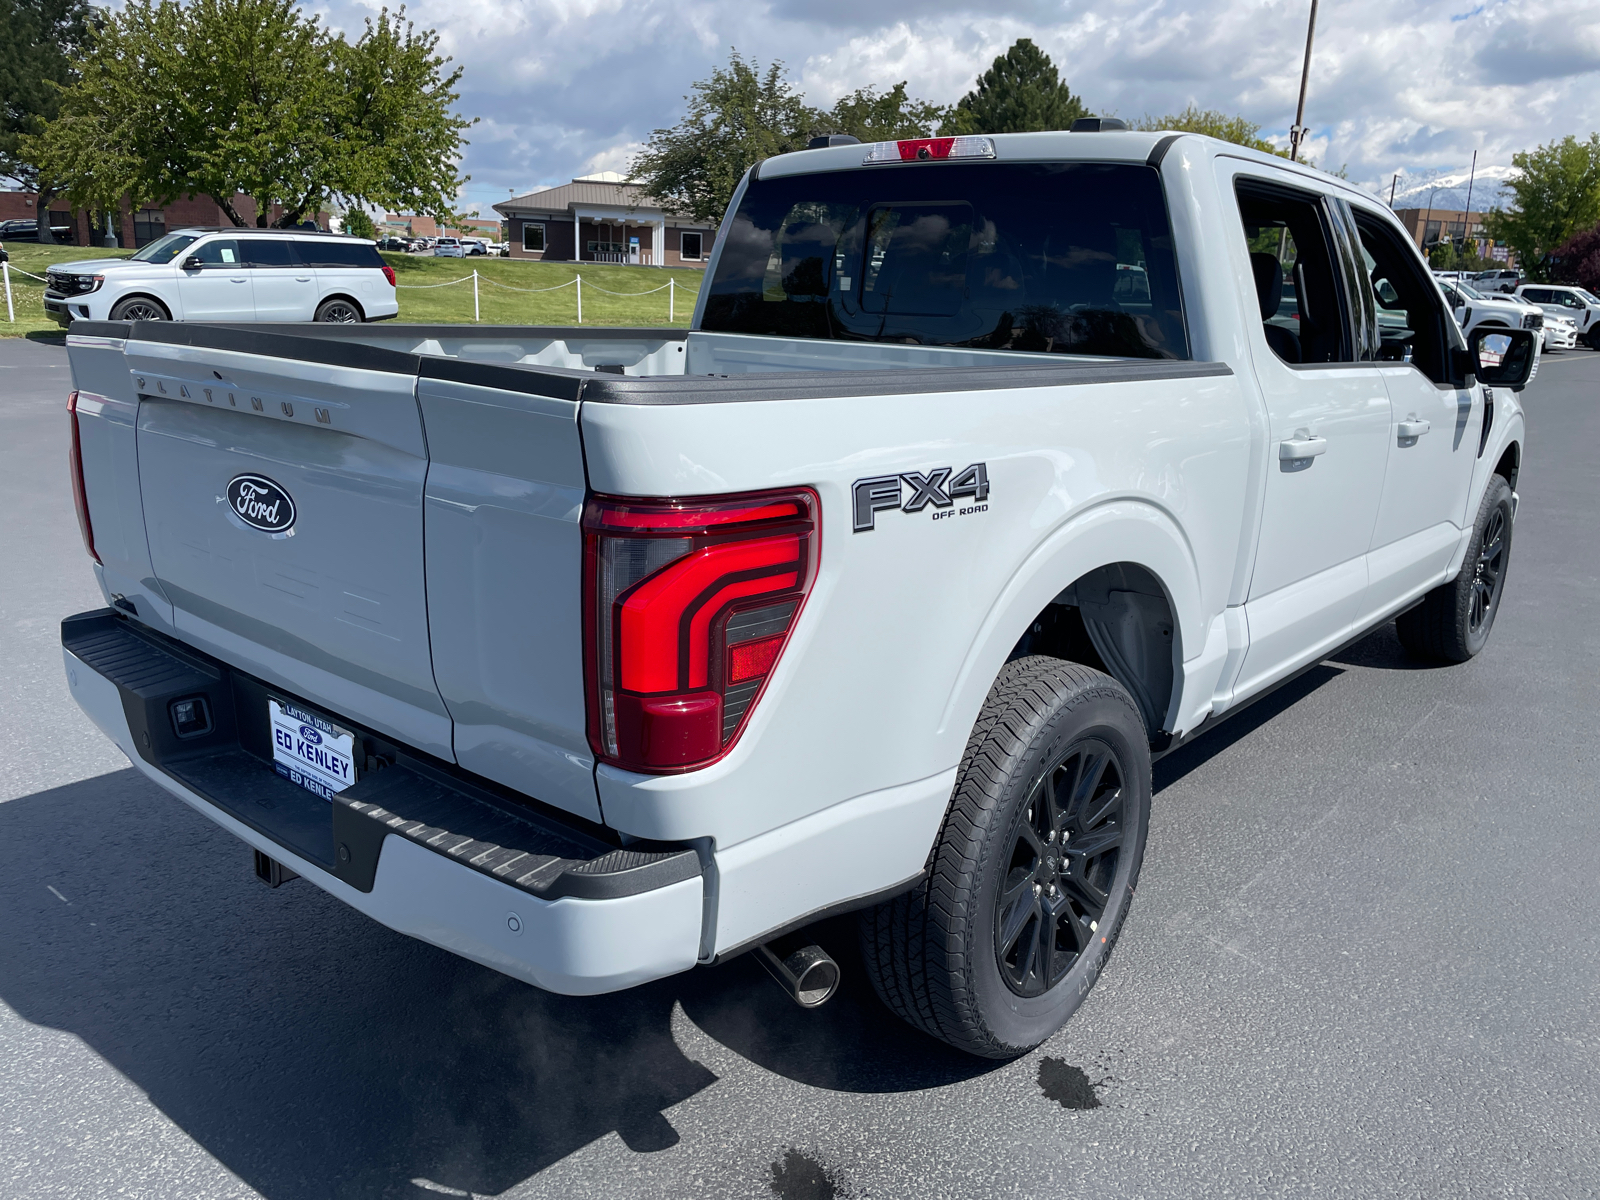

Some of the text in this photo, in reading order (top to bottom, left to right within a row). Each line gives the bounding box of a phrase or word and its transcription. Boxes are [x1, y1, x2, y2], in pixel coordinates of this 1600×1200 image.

[136, 377, 332, 425] PLATINUM
[236, 481, 281, 524] Ford
[851, 461, 990, 534] FX4
[932, 504, 989, 521] OFF ROAD
[286, 705, 332, 733] LAYTON, UTAH
[303, 727, 319, 743] Ford
[275, 728, 293, 751] ED
[297, 738, 349, 779] KENLEY
[290, 770, 302, 785] ED
